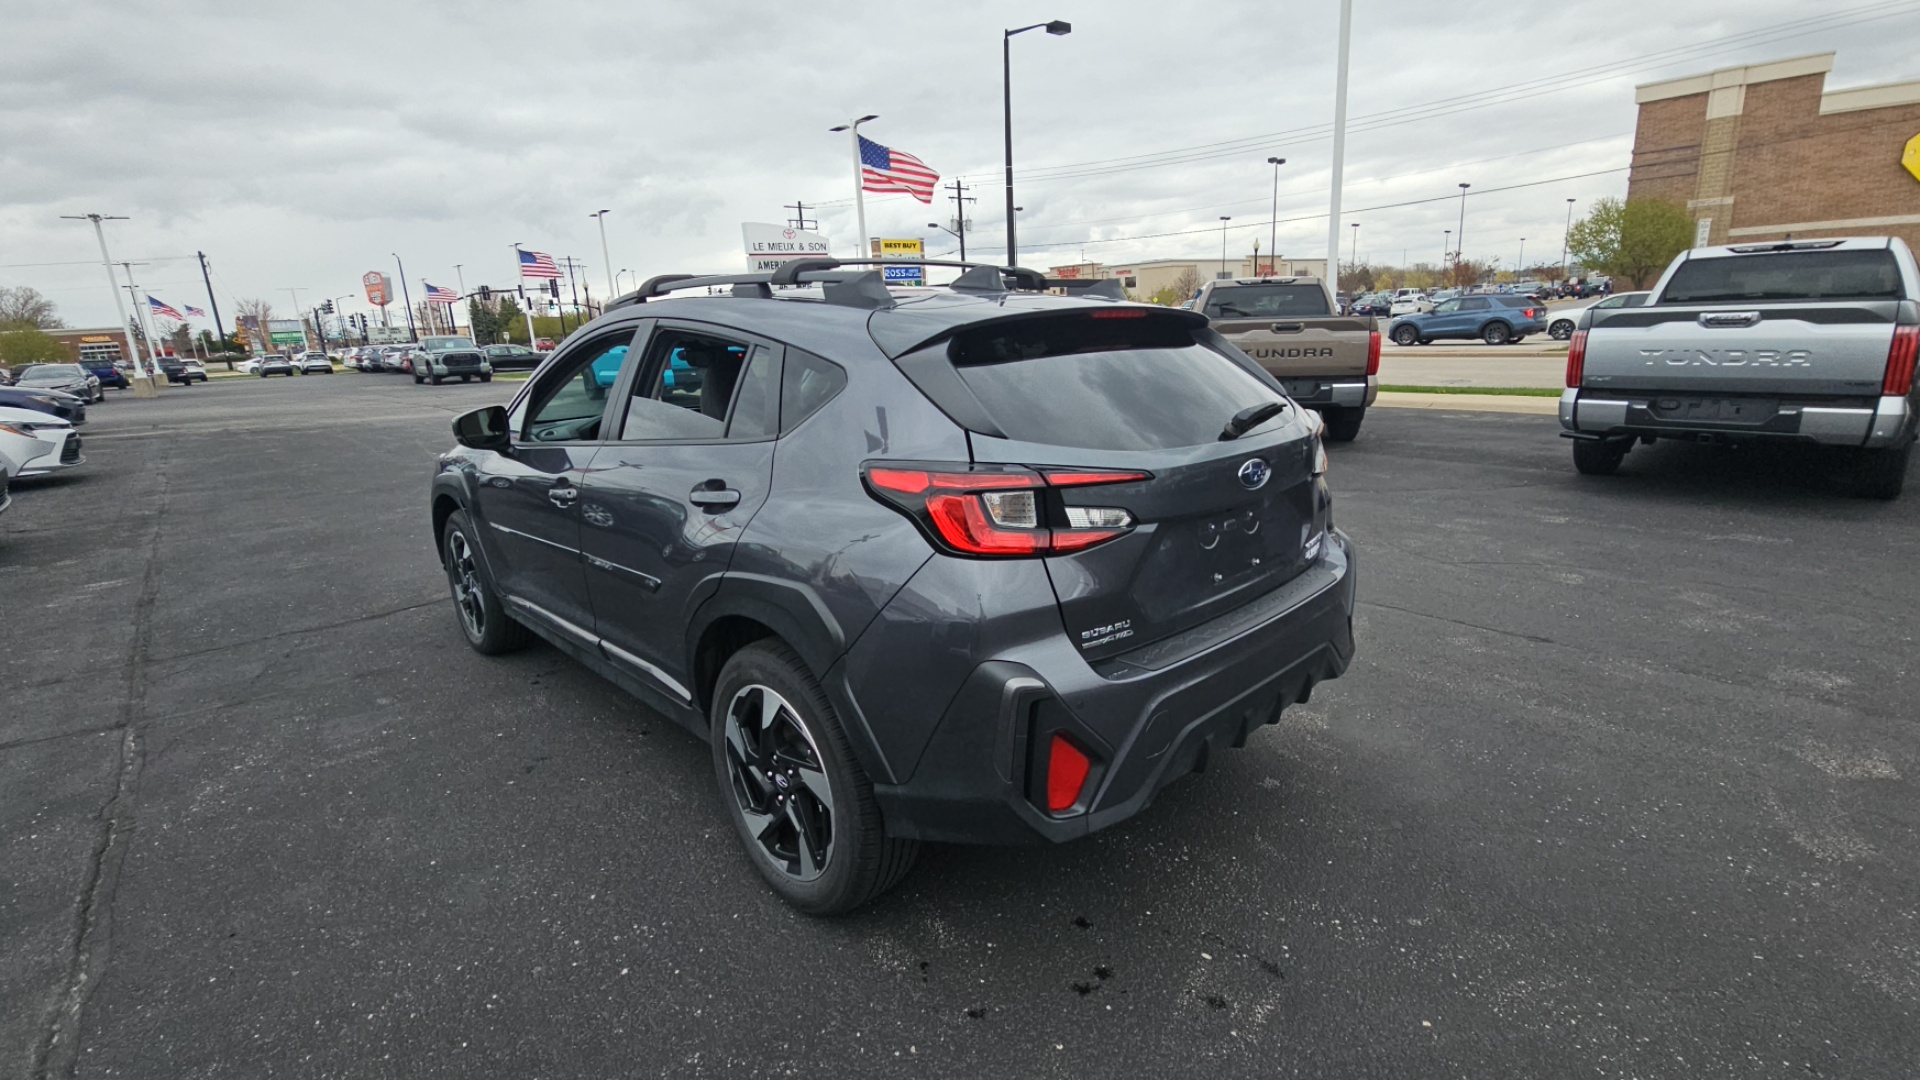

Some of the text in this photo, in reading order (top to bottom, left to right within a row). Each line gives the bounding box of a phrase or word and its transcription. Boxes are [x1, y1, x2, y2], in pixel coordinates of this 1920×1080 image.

[752, 242, 827, 251] LE MIEUX & SON
[884, 268, 906, 277] ROSS
[1639, 349, 1813, 367] TUNDRA
[1081, 619, 1131, 639] SUBARU
